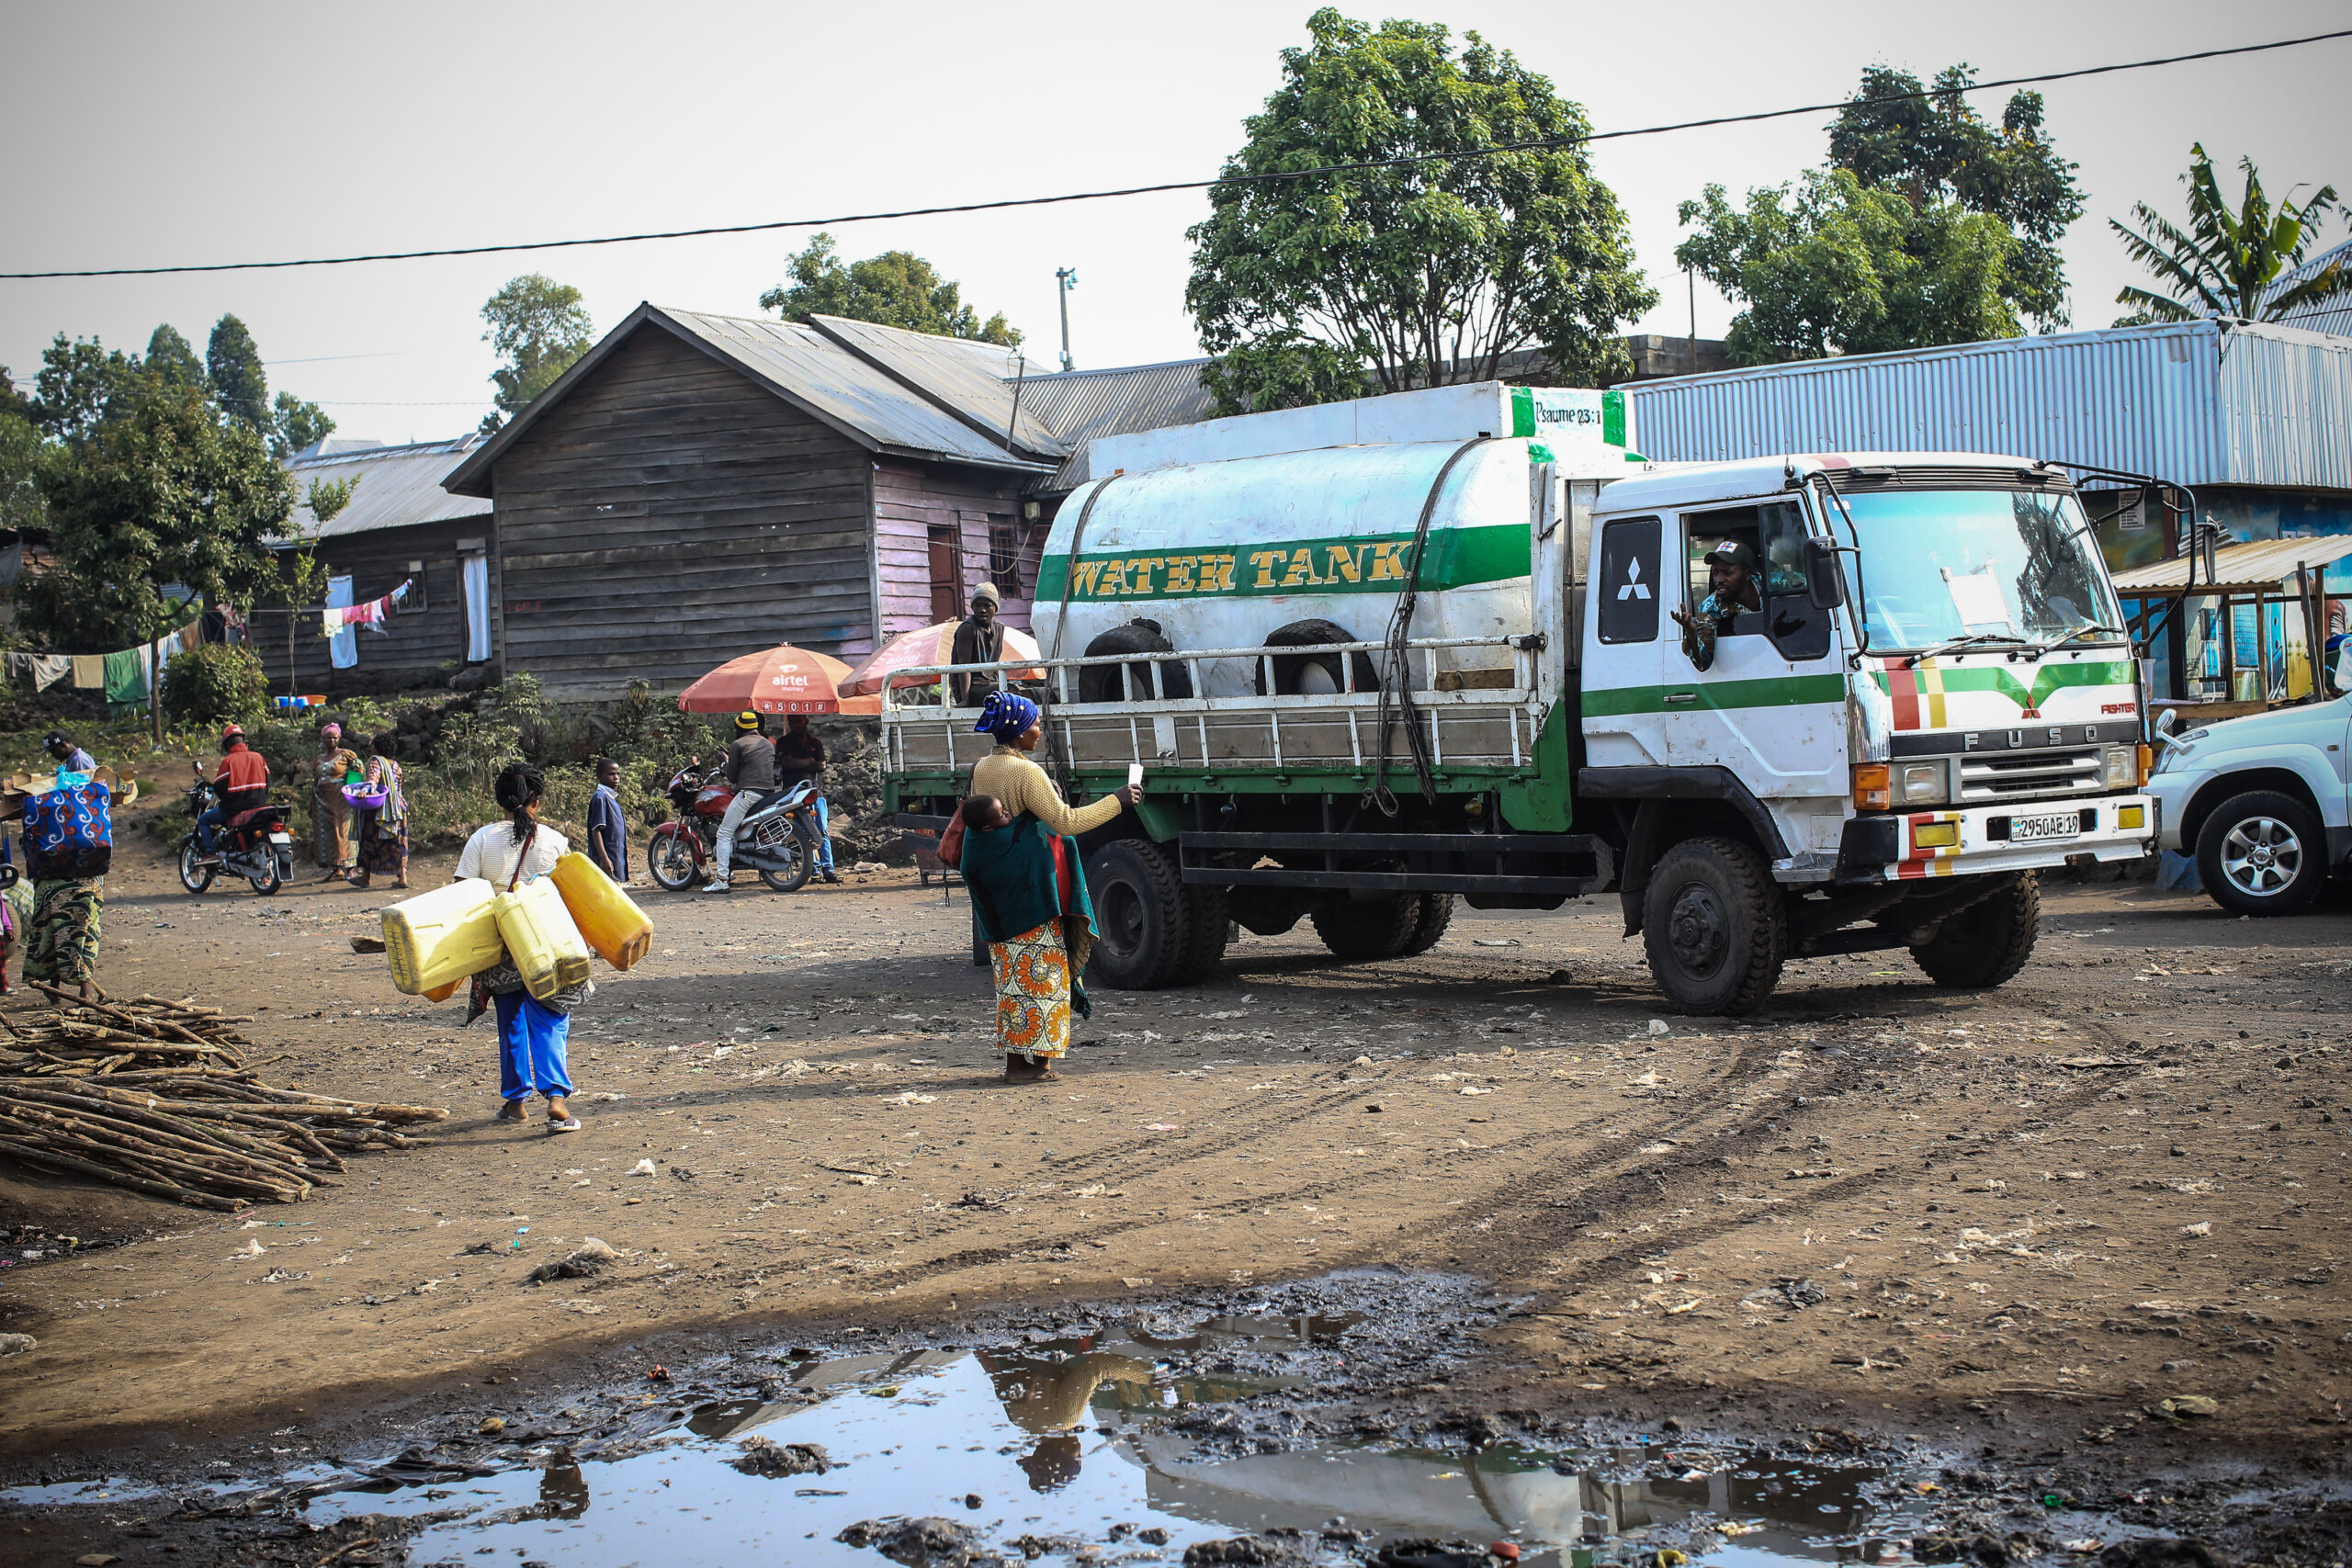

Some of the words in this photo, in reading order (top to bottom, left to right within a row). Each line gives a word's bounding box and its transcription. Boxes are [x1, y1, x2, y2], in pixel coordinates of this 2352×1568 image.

[1535, 401, 1576, 423] Psaume
[1577, 409, 1601, 424] 23:1
[1070, 553, 1237, 596] WATER
[1249, 540, 1414, 590] TANK
[772, 674, 809, 686] airtel
[2100, 702, 2136, 715] FIGHTER
[1963, 725, 2098, 751] FUSO
